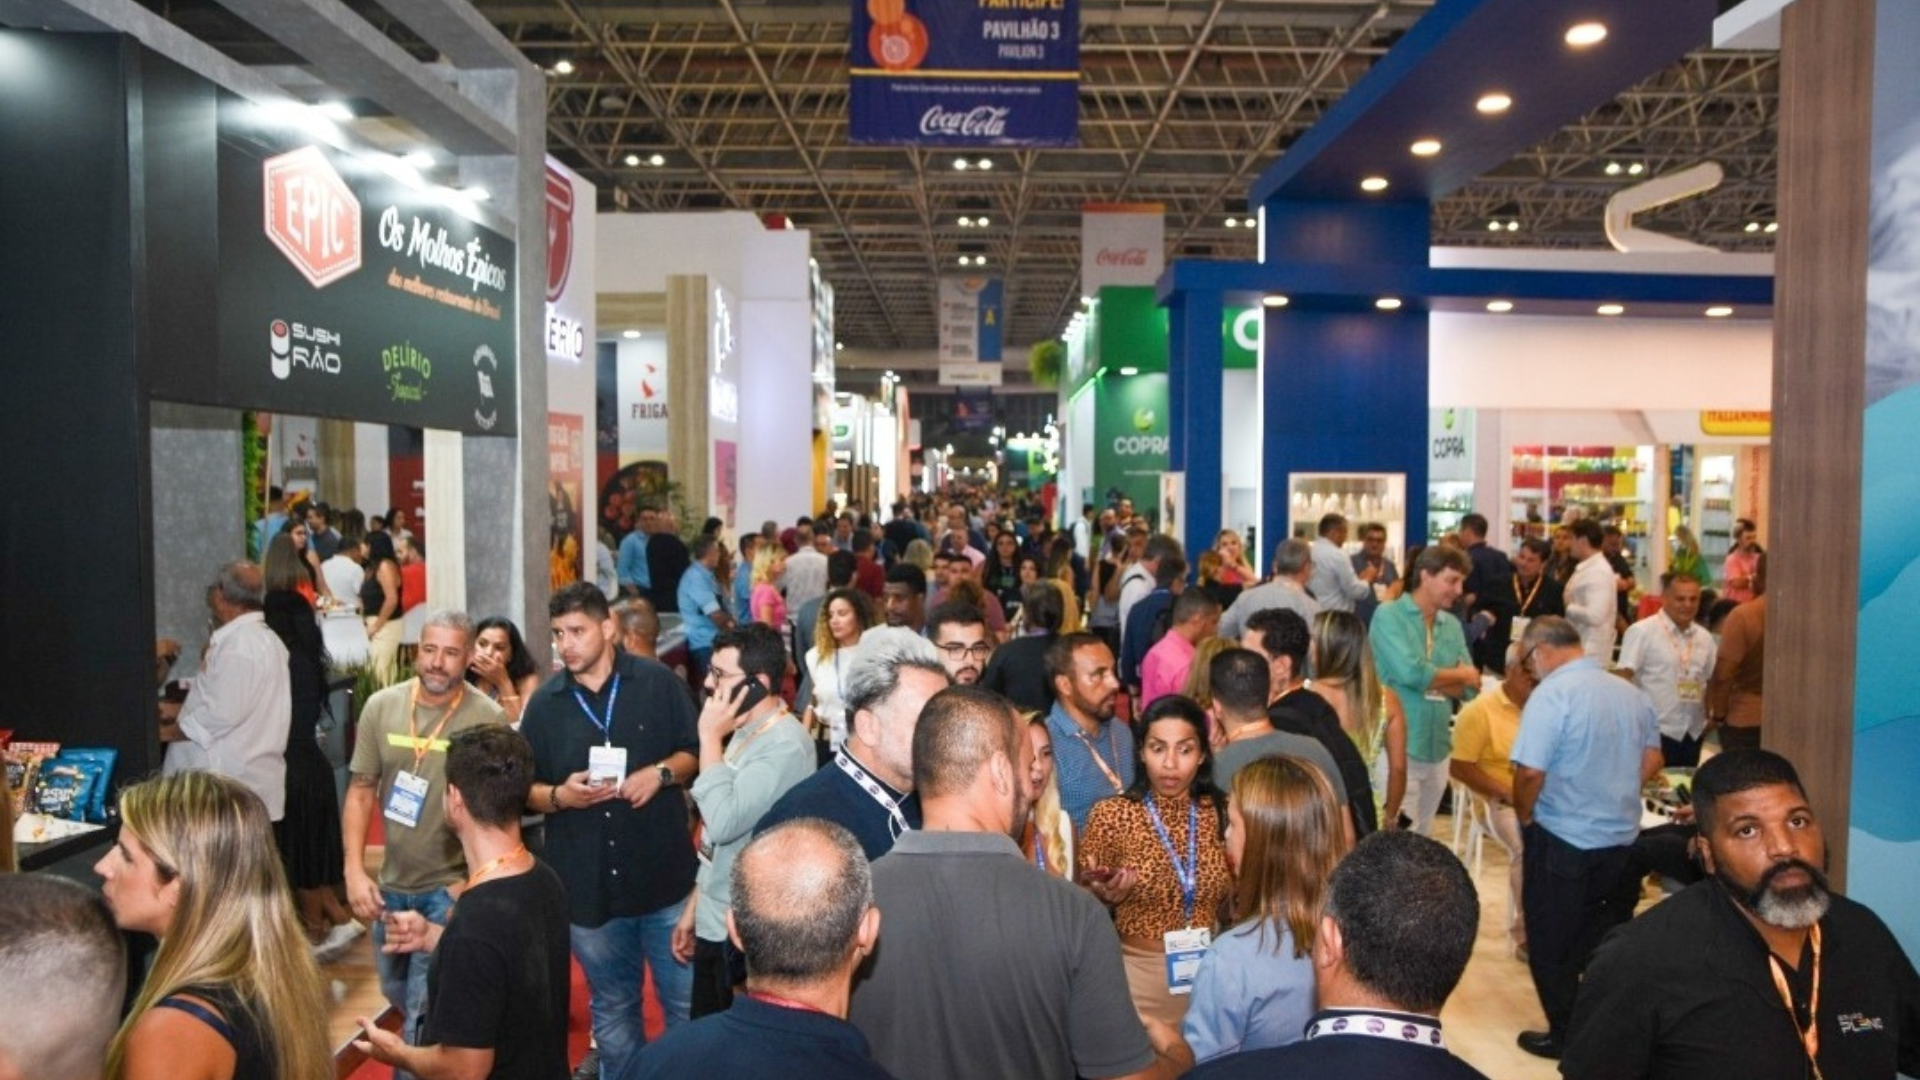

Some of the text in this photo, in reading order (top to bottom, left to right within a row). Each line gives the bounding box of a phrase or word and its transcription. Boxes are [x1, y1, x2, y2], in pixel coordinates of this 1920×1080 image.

[983, 18, 1060, 39] PAVILHÃO 3
[284, 175, 344, 260] EPIC
[379, 205, 405, 252] Os
[407, 215, 463, 276] Molhos
[292, 345, 341, 375] RÃO
[382, 340, 431, 379] DELÍRIO
[1433, 436, 1465, 459] COPRA
